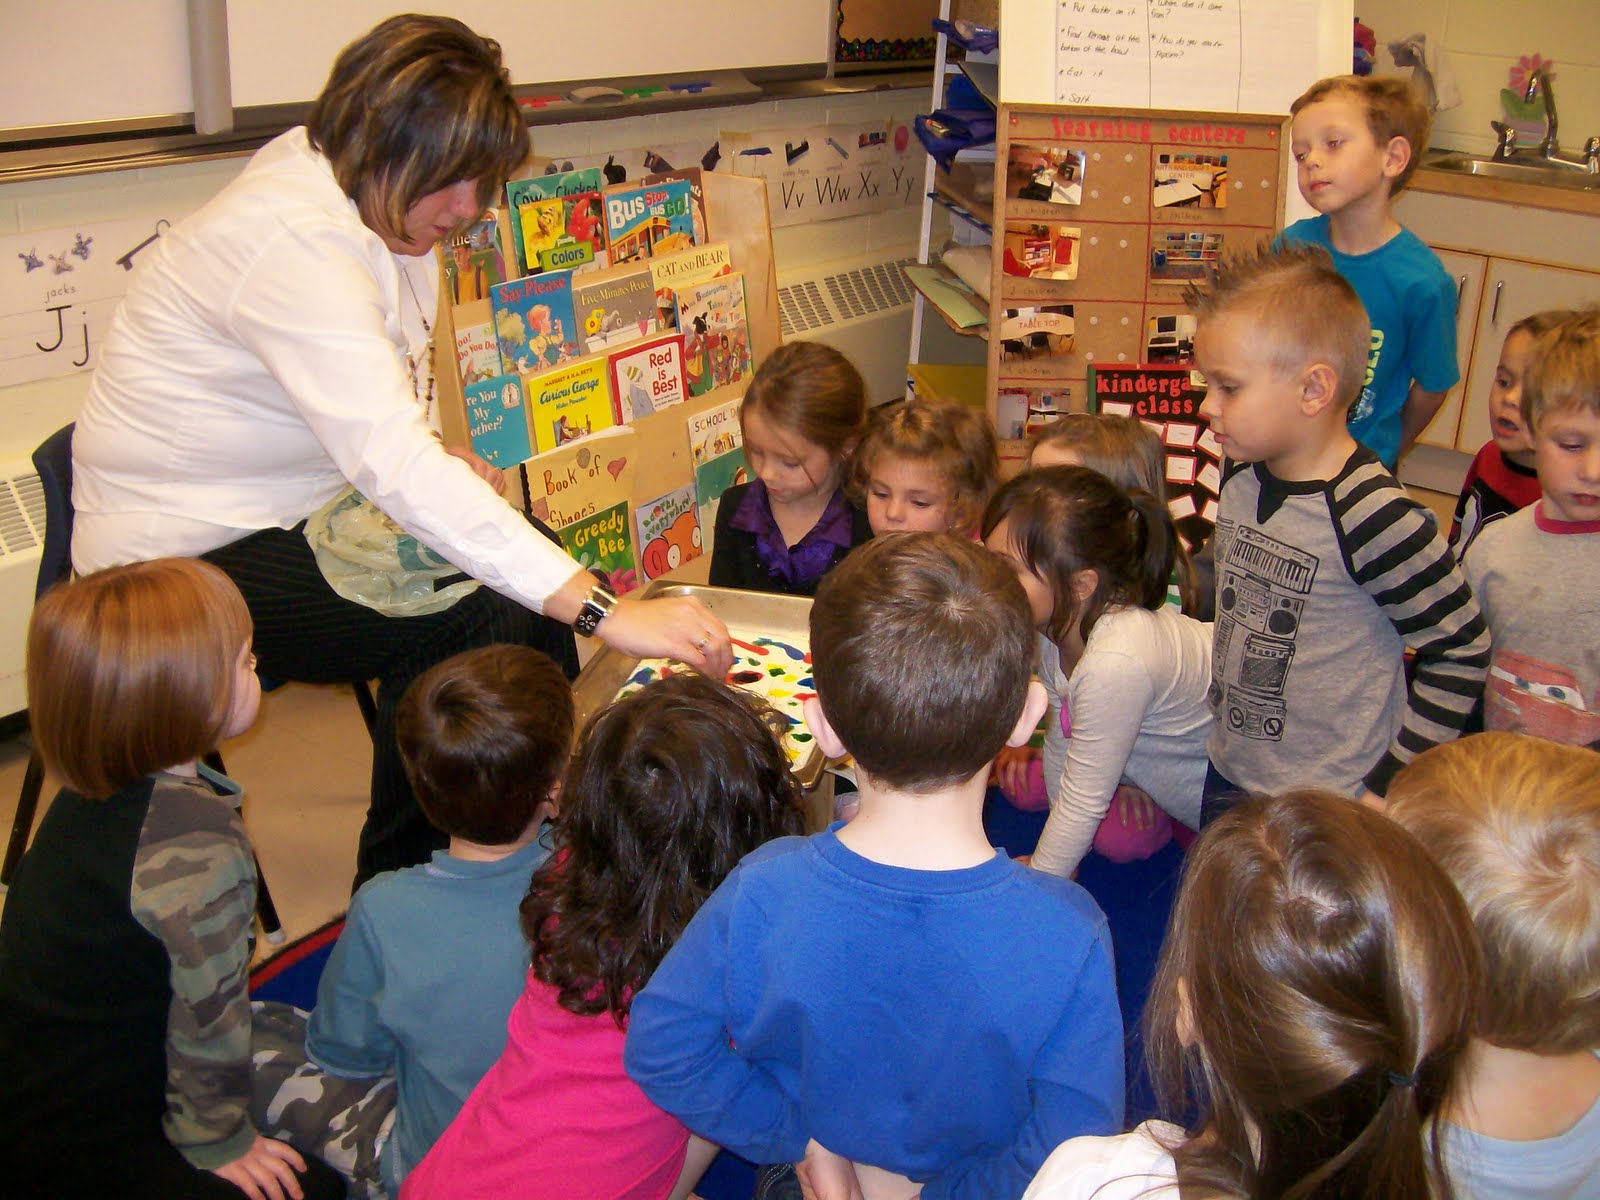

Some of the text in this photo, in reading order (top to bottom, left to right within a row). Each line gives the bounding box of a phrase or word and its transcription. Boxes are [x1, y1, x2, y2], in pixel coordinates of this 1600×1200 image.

[1069, 92, 1091, 104] Salt
[1052, 115, 1248, 144] learning centers
[608, 196, 645, 229] Bus
[551, 248, 585, 266] Colors
[657, 262, 677, 278] CAT
[679, 261, 695, 273] AND
[695, 250, 724, 269] BEAR
[45, 283, 76, 303] jacks
[499, 277, 567, 304] Say Please
[1019, 319, 1061, 329] TABLE TOP
[469, 343, 483, 352] You
[649, 347, 672, 369] Red
[652, 374, 678, 396] Best
[657, 367, 667, 381] is
[1096, 373, 1192, 397] kinderga
[466, 389, 497, 407] re You
[539, 378, 600, 405] Curious George
[473, 407, 491, 421] My
[1136, 395, 1193, 416] class
[470, 415, 503, 438] other?
[694, 411, 728, 433] SCHOOL
[543, 453, 601, 496] Book of
[575, 509, 624, 548] Greedy
[598, 537, 626, 558] Bee
